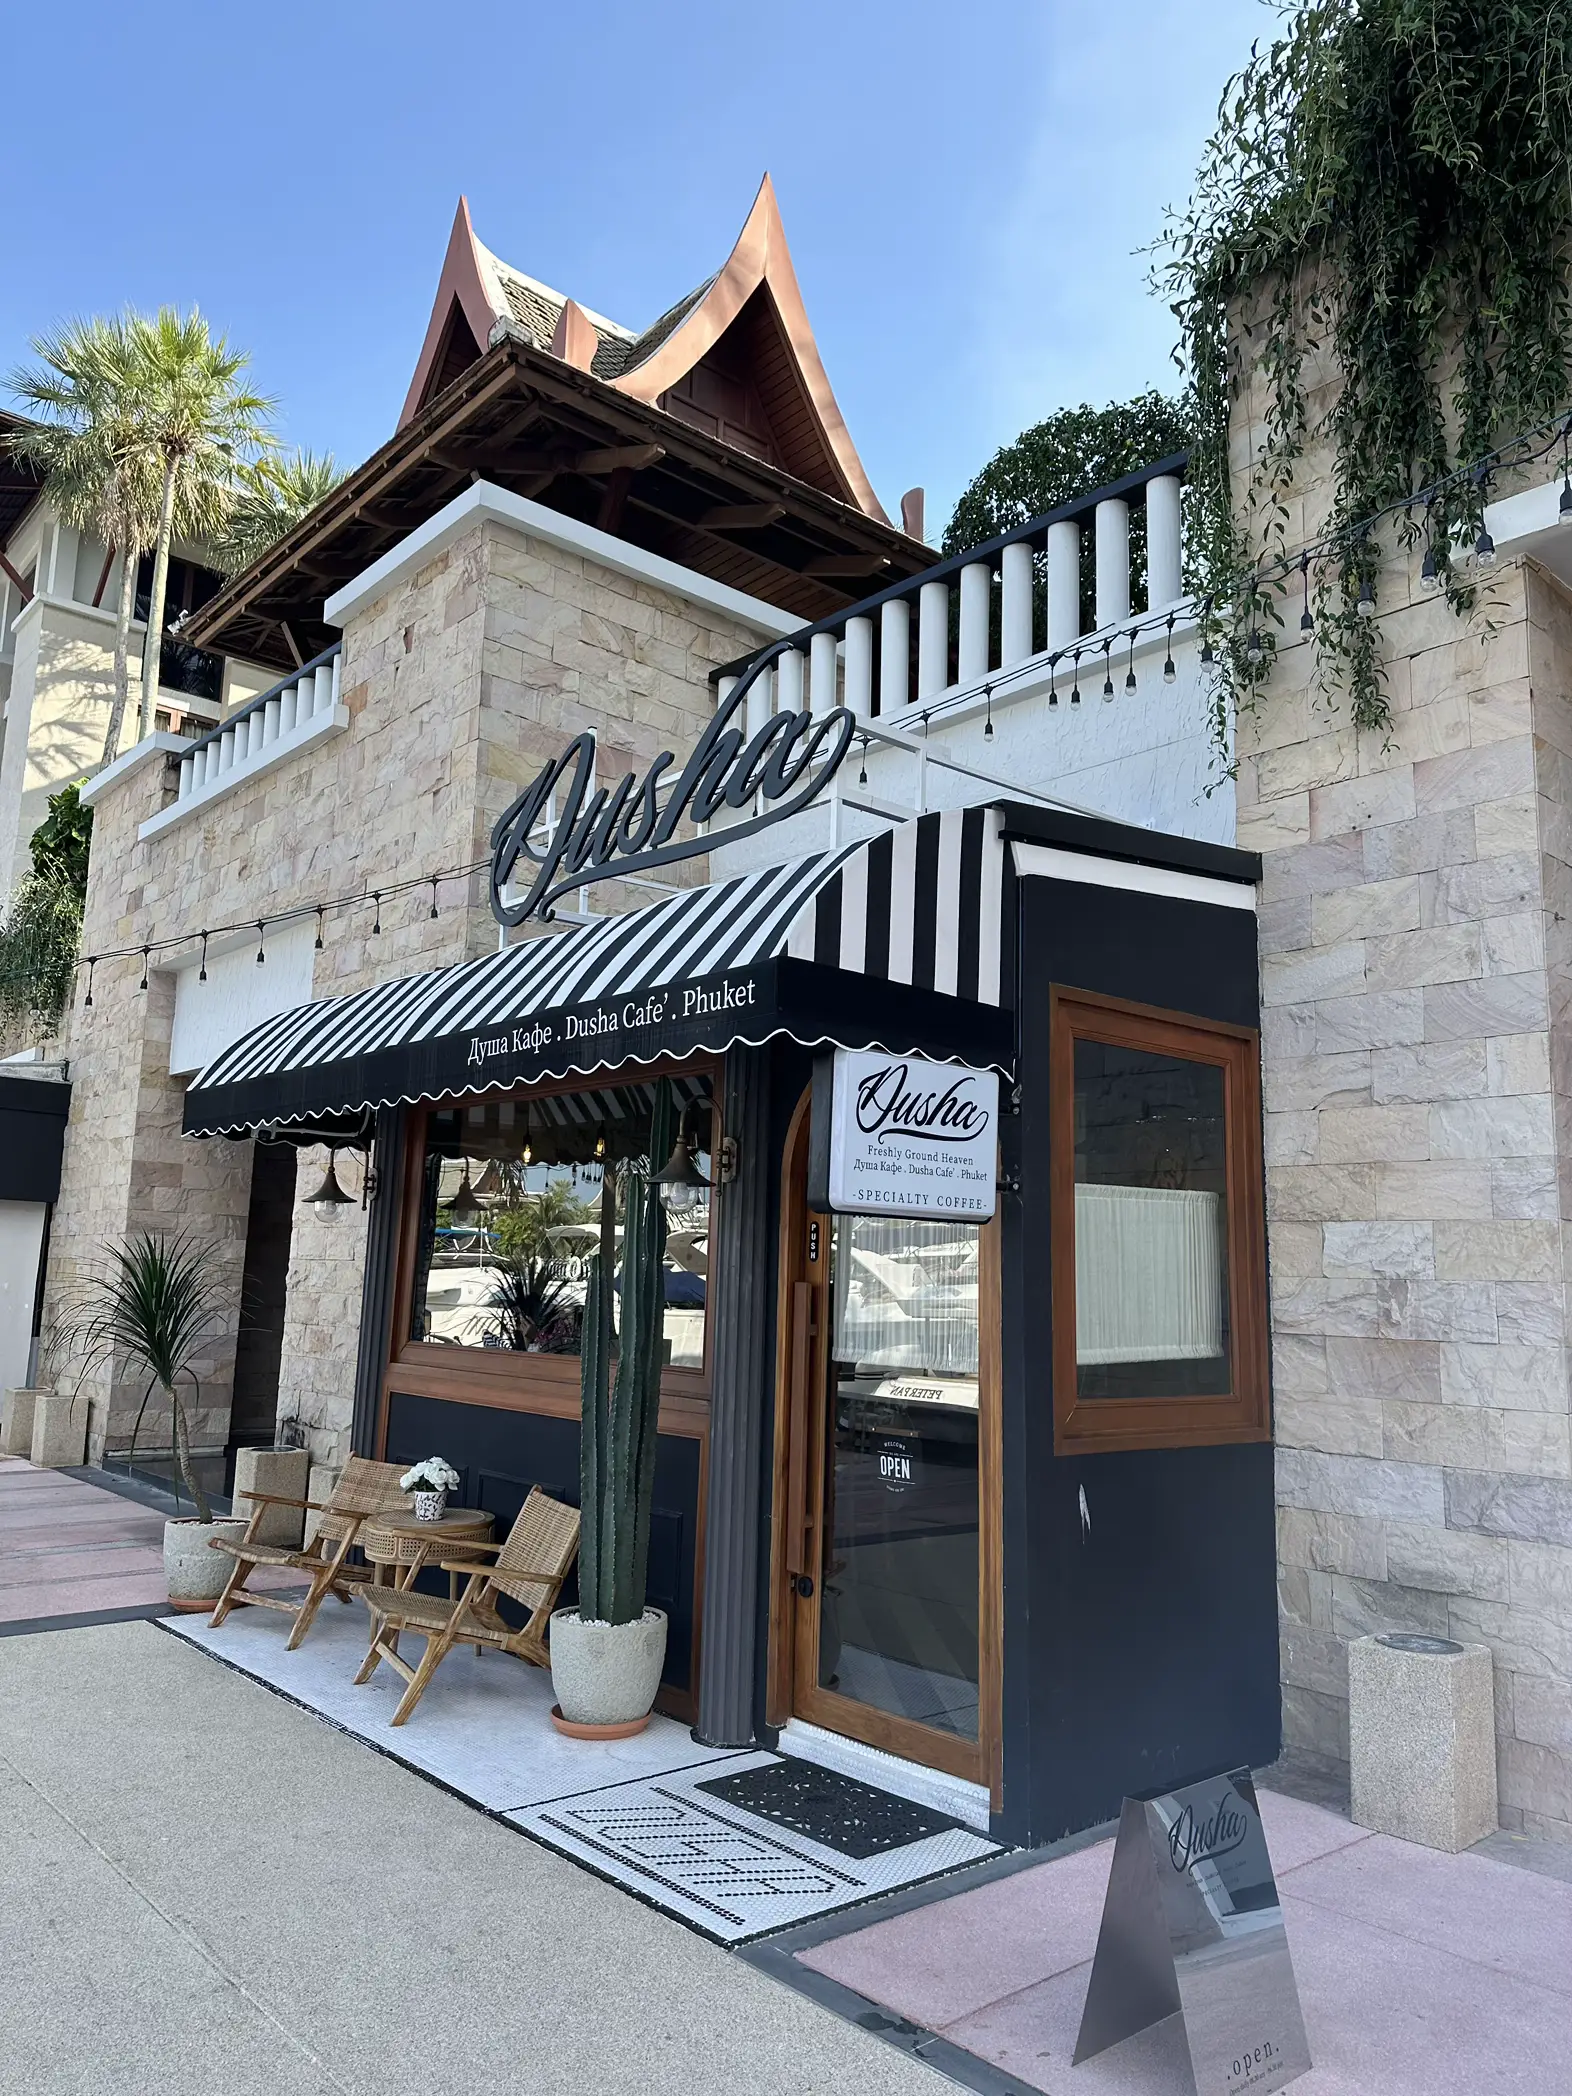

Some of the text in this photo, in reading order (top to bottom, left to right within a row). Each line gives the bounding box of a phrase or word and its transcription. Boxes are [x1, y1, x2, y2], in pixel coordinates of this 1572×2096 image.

[489, 641, 856, 927] Dusha
[565, 1007, 619, 1040] Dusha
[682, 979, 756, 1017] Phuket
[467, 1023, 552, 1066] Душа Кафе
[855, 1063, 990, 1145] Dusha
[853, 1158, 903, 1175] Душа Кафе
[867, 1144, 974, 1166] Freshly Ground Heaven
[908, 1164, 934, 1176] Dusha
[961, 1169, 988, 1181] Phuket
[883, 1441, 906, 1451] WELCOME
[880, 1455, 911, 1479] OPEN
[1168, 1791, 1248, 1876] Dusha
